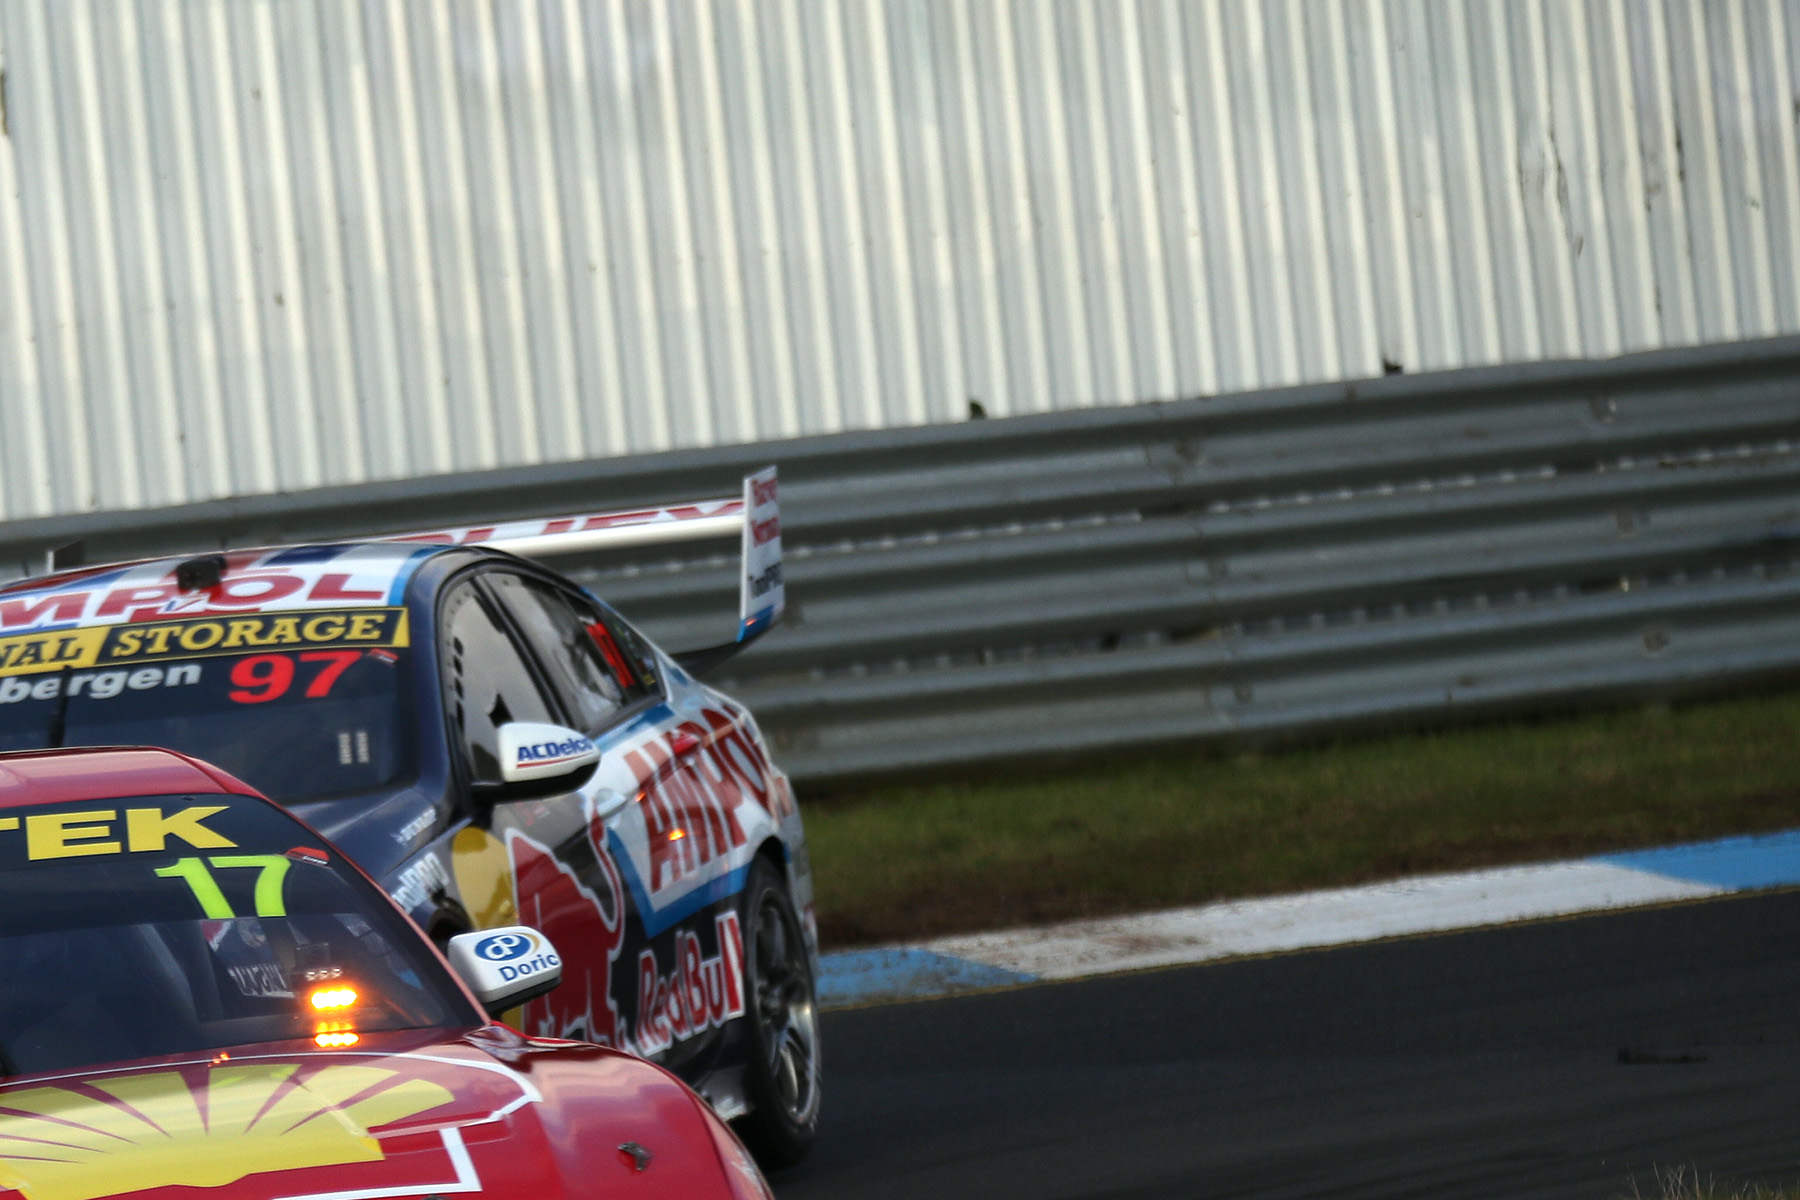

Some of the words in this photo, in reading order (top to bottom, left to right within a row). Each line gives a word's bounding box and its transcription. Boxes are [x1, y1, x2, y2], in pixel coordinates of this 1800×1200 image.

[113, 615, 386, 657] STORAGE
[229, 651, 362, 704] 97
[154, 855, 291, 918] 17
[498, 953, 559, 981] Doric
